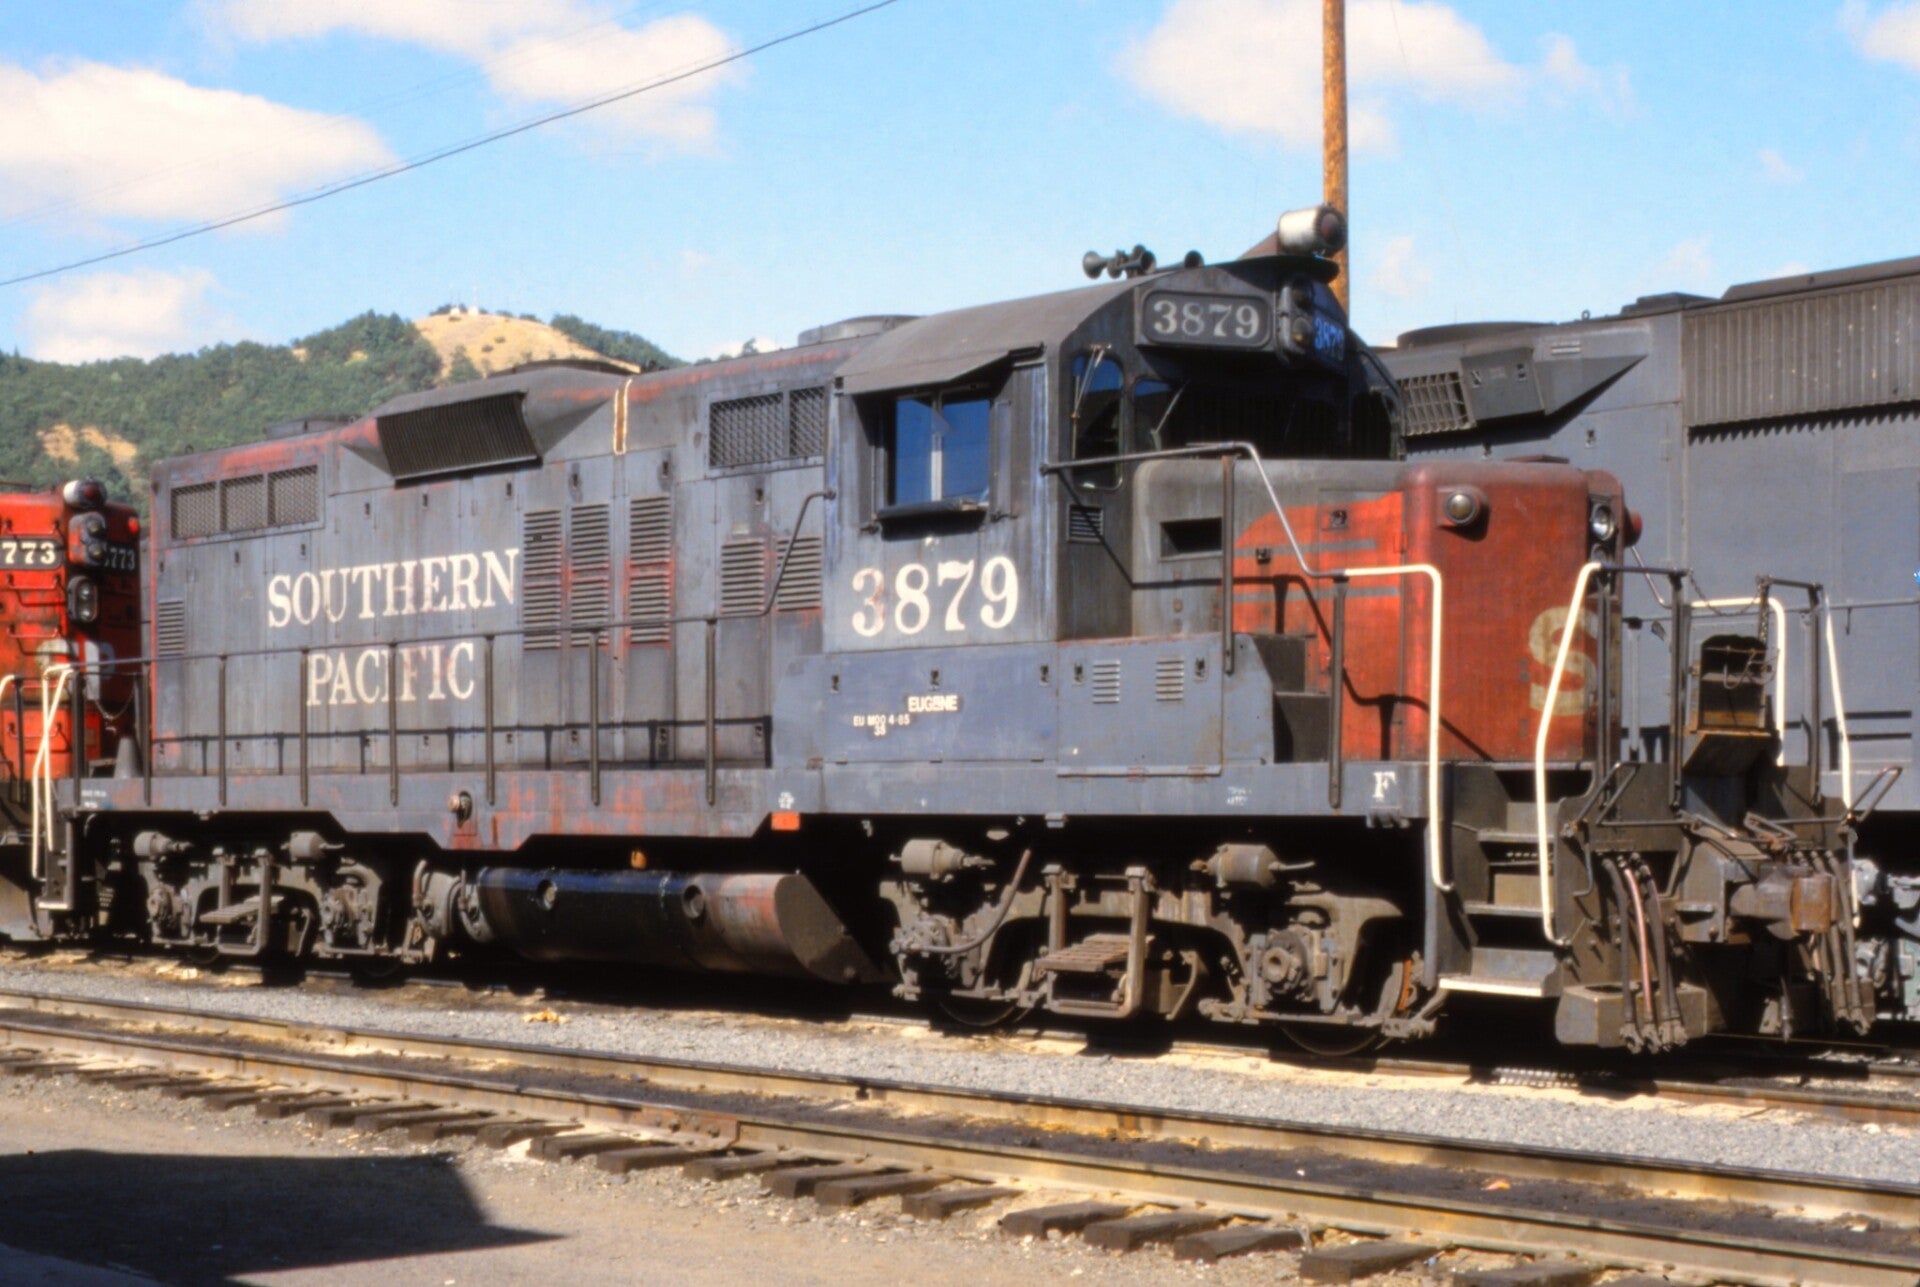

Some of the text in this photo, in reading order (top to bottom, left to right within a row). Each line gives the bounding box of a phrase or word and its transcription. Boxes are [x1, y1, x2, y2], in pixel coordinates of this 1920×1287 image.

[1153, 300, 1260, 339] 3879
[2, 541, 56, 564] 773
[268, 548, 519, 627] SOUTHERN
[852, 555, 1019, 637] 3879
[908, 695, 959, 713] EUGENE
[1372, 771, 1397, 800] F
